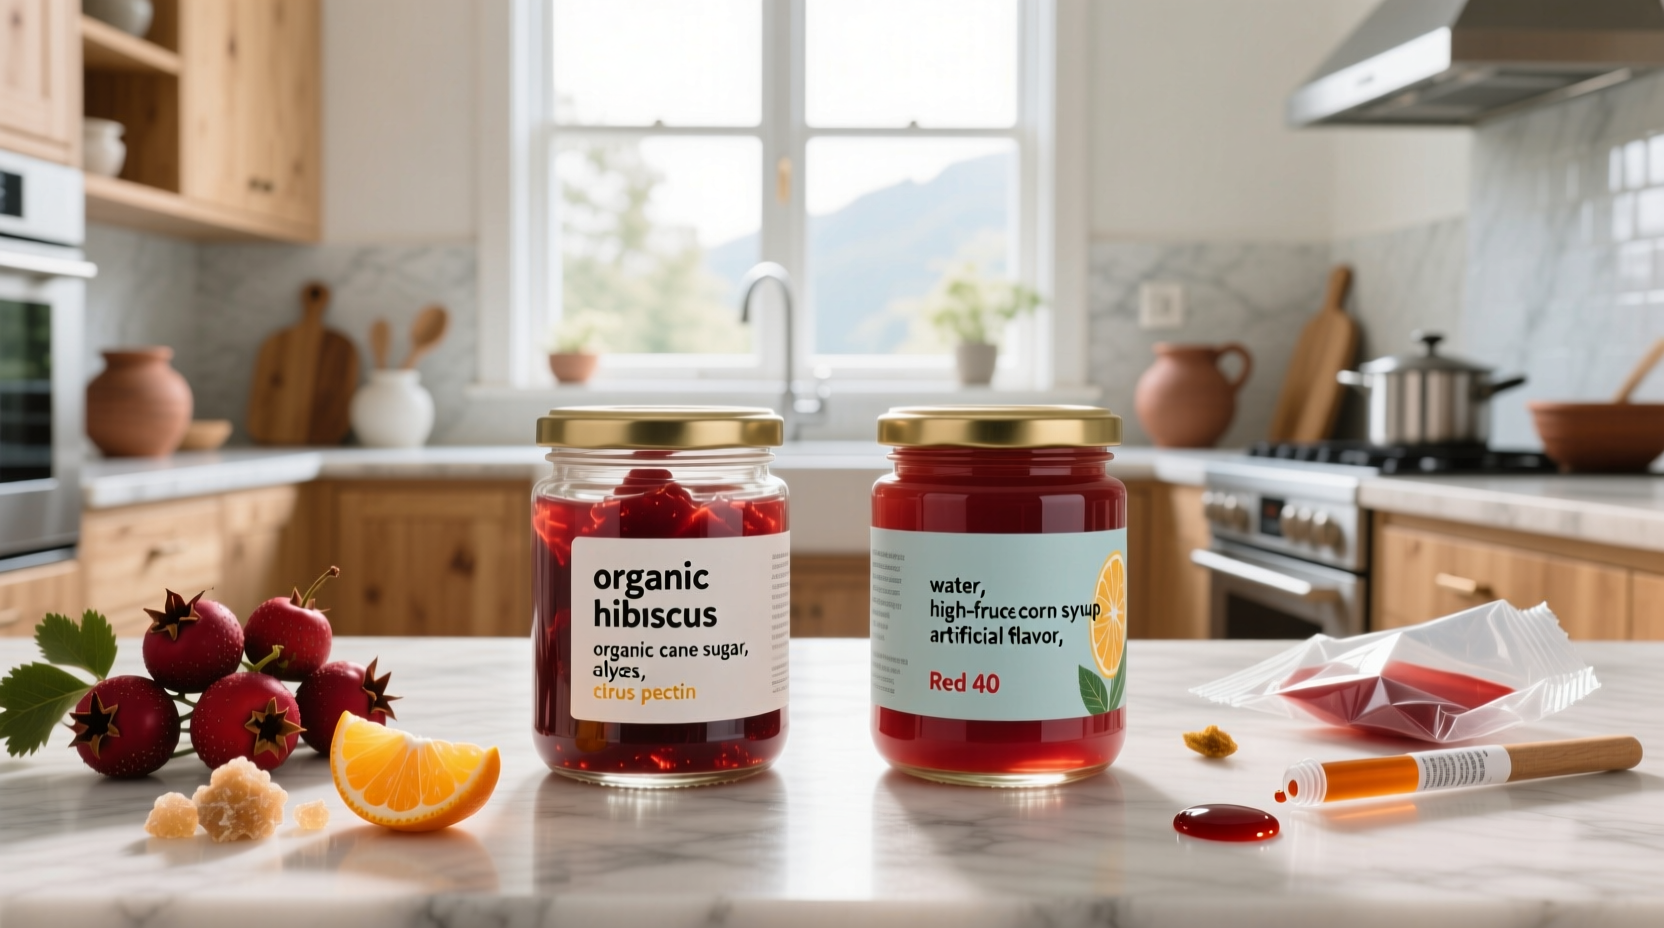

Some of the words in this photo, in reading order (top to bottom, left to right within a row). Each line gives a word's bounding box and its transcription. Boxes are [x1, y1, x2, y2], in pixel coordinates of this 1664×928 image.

[593, 560, 709, 599] organic
[930, 577, 986, 598] water,
[1018, 605, 1057, 618] corn
[930, 626, 1003, 644] artificial
[1008, 626, 1063, 647] flavor,
[593, 641, 654, 661] organic
[659, 644, 698, 658] cane
[703, 641, 748, 660] sugar,
[929, 671, 967, 692] Red
[972, 673, 1000, 693] 40
[593, 683, 635, 700] cirus
[641, 683, 696, 705] pectin
